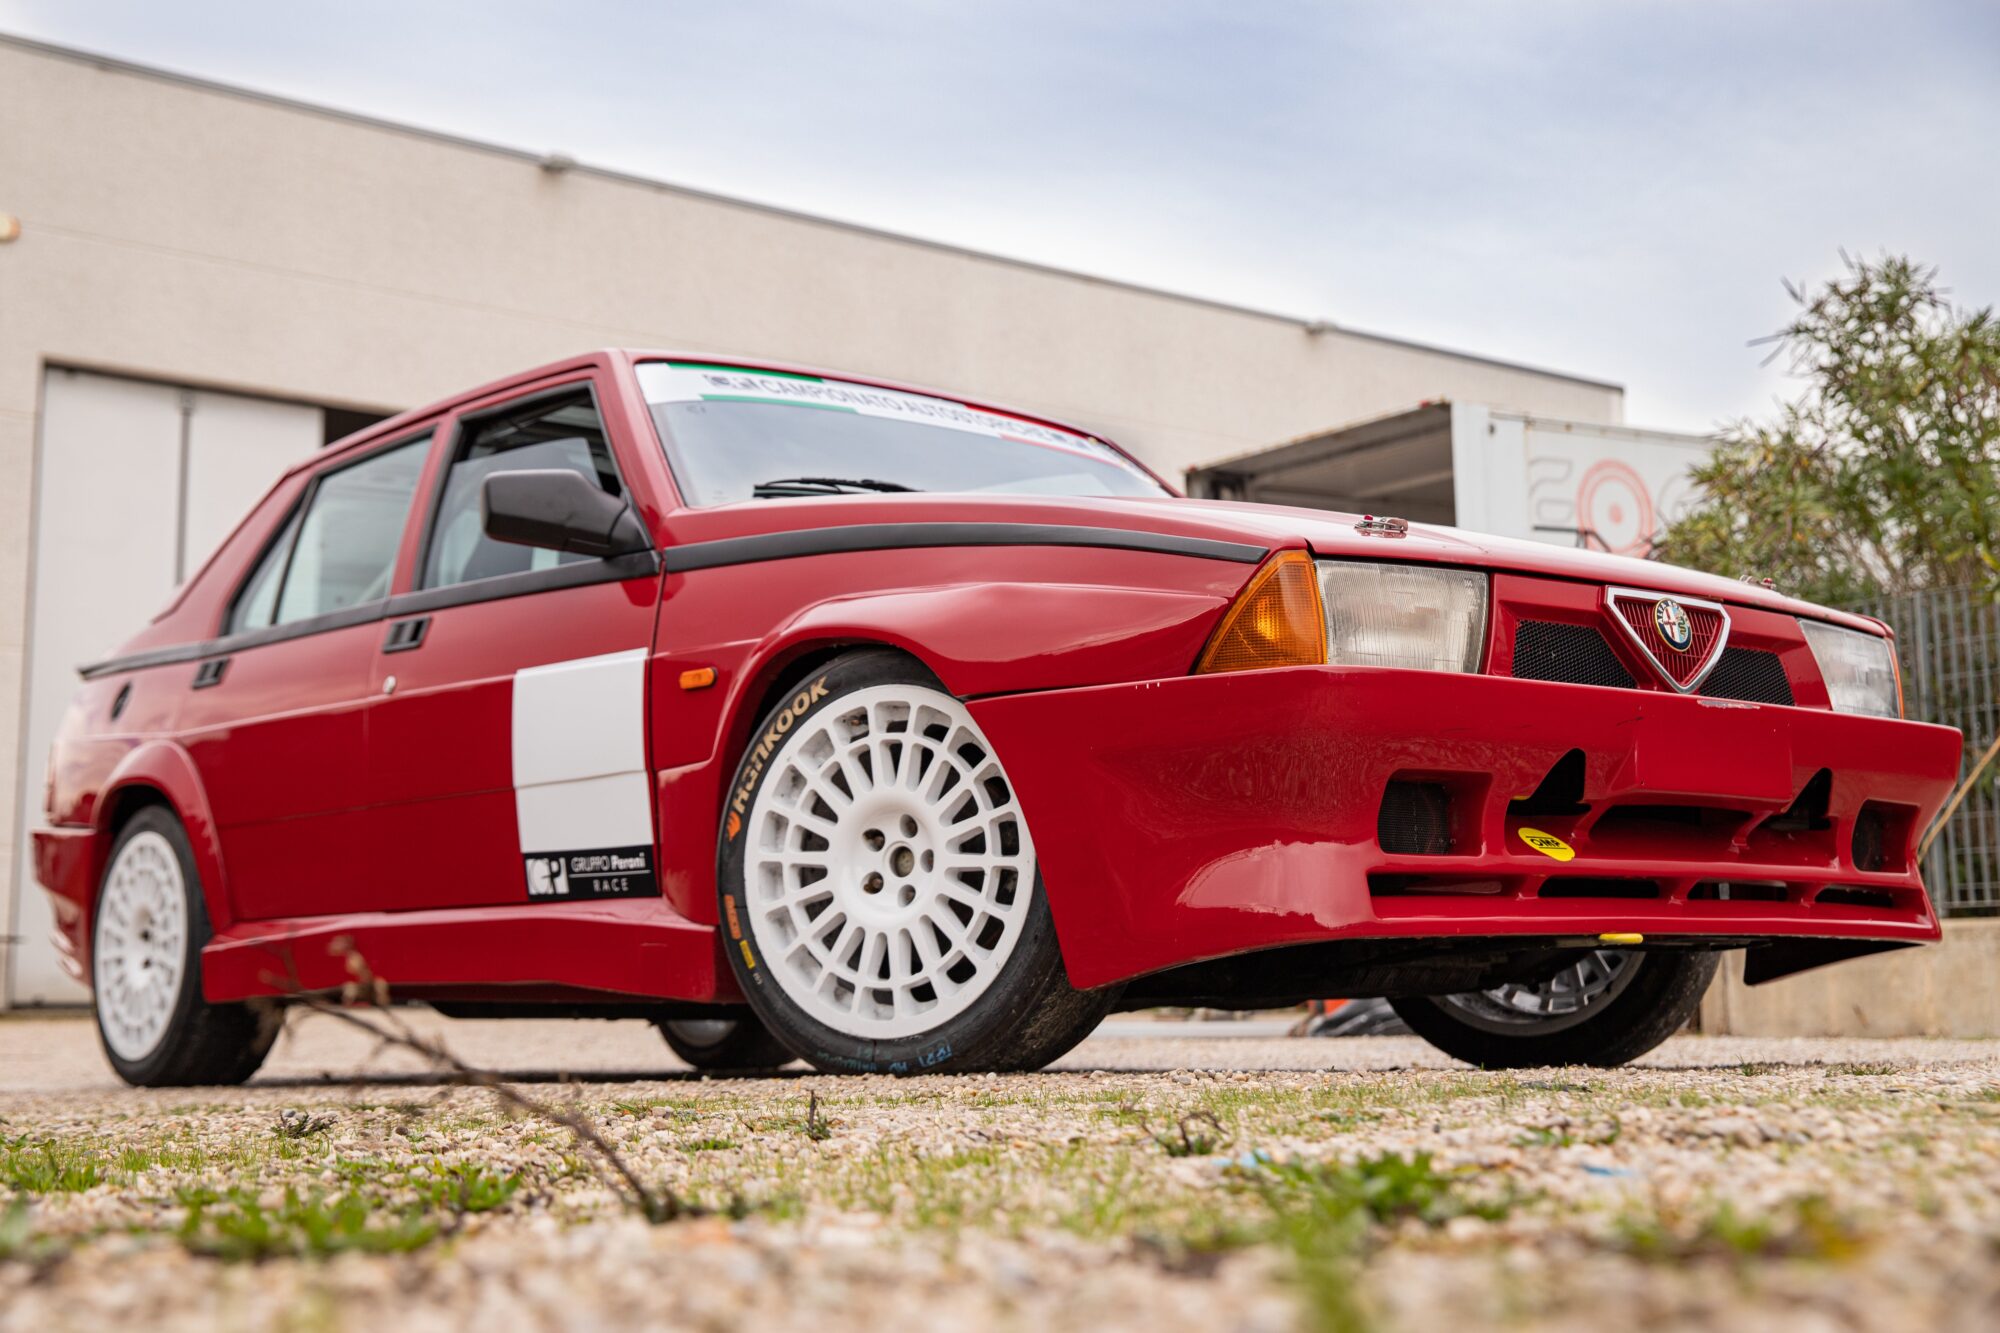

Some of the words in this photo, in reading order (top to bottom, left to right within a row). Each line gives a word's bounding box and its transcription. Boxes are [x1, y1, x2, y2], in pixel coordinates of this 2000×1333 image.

[760, 378, 902, 411] CAMPIONATO
[570, 855, 611, 873] GRUPPO
[592, 877, 630, 893] RACE
